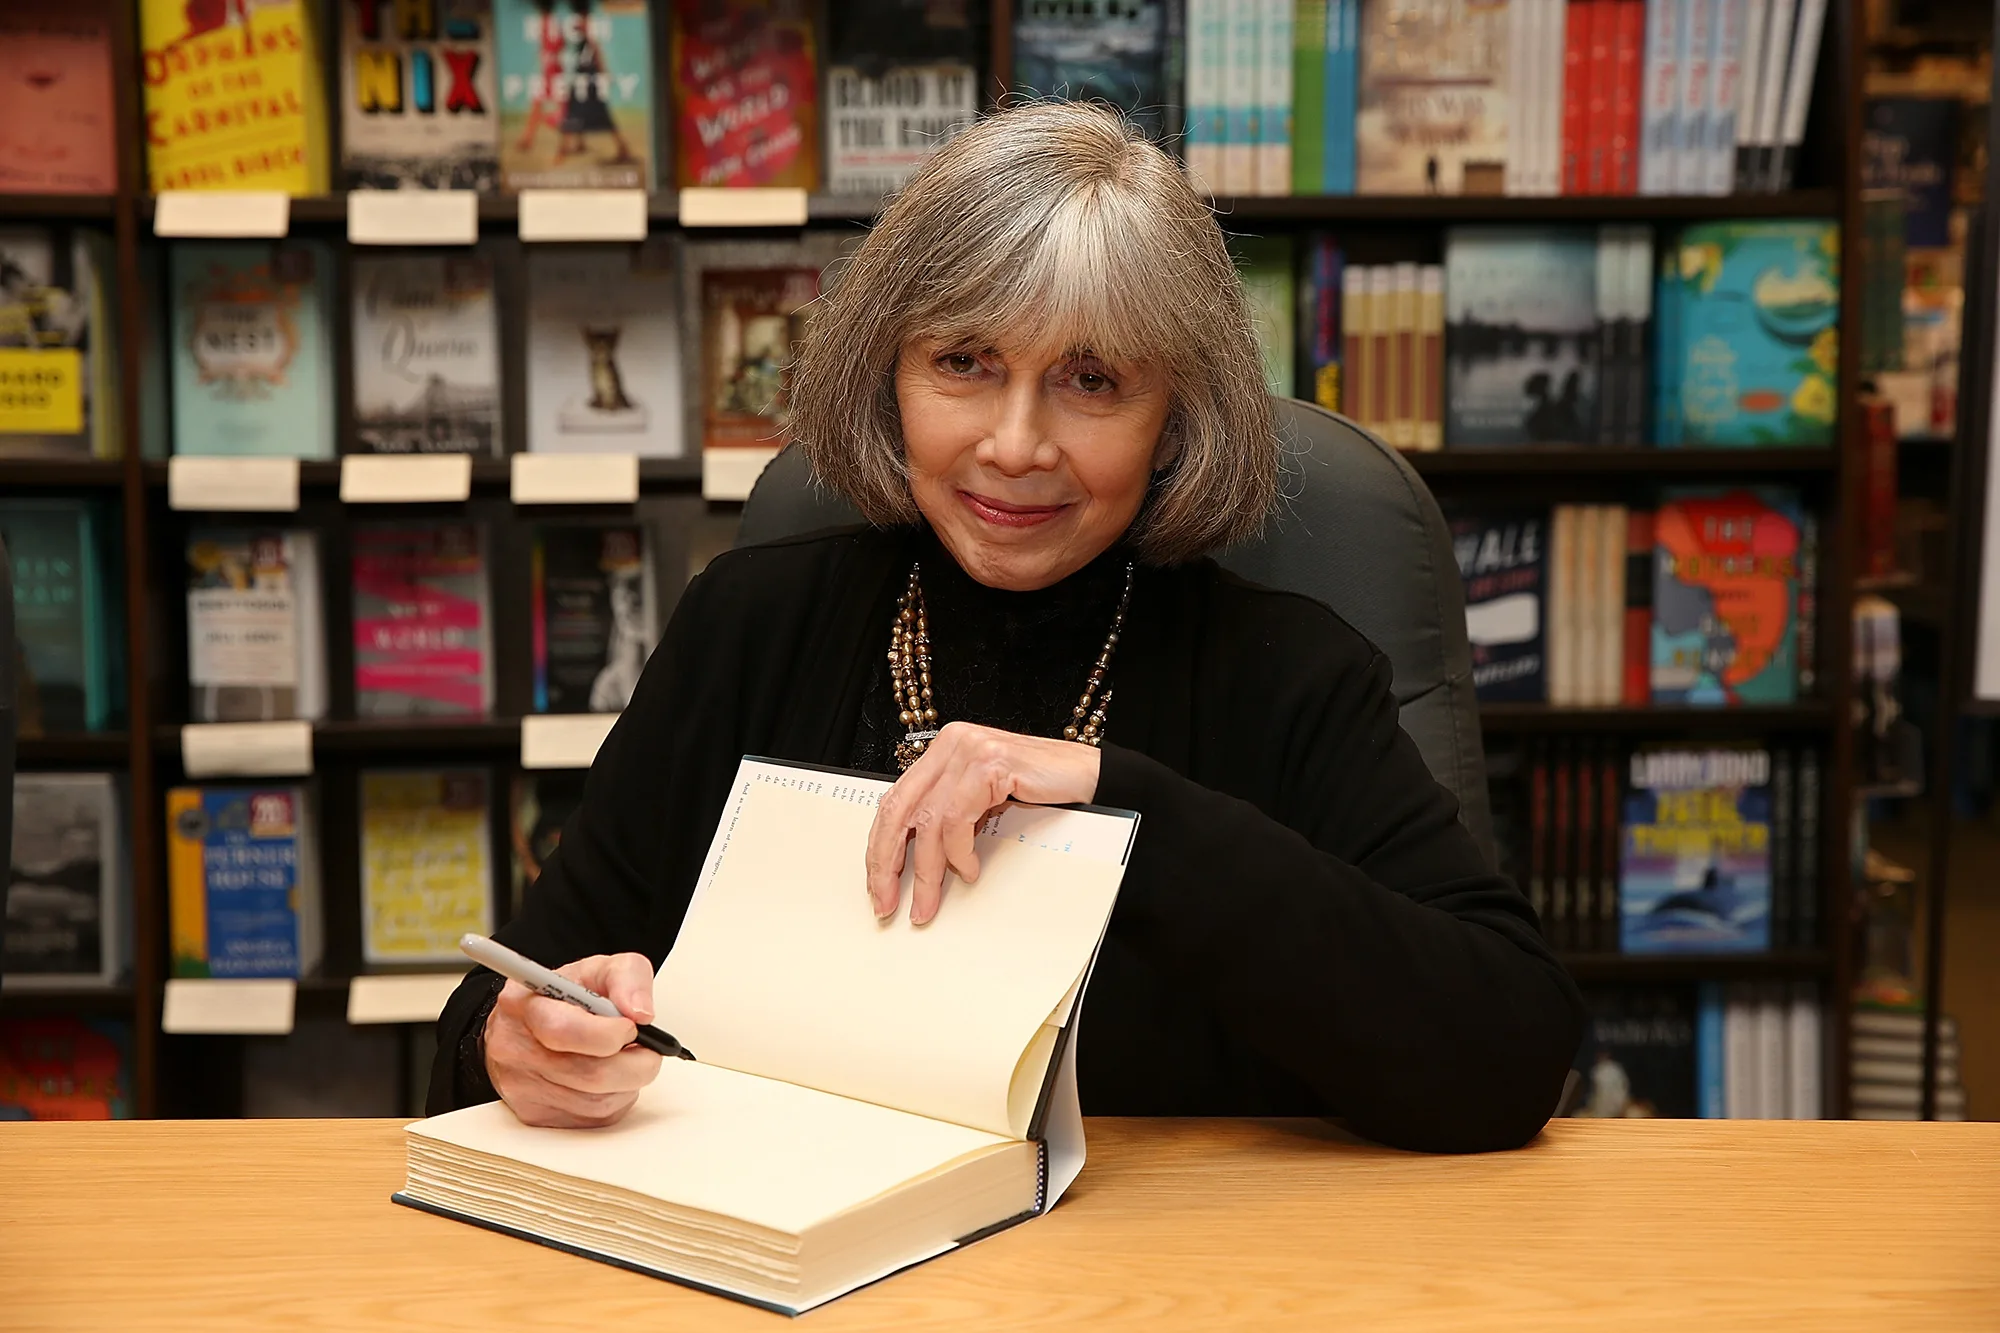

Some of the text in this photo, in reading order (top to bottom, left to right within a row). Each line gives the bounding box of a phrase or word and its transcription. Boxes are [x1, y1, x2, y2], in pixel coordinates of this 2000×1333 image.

[357, 48, 486, 114] NIX
[503, 73, 639, 101] PRETTY
[146, 89, 300, 147] CARNIVAL
[696, 82, 790, 147] WORLD
[205, 329, 275, 352] NEST
[742, 782, 750, 795] And
[729, 817, 738, 831] learn
